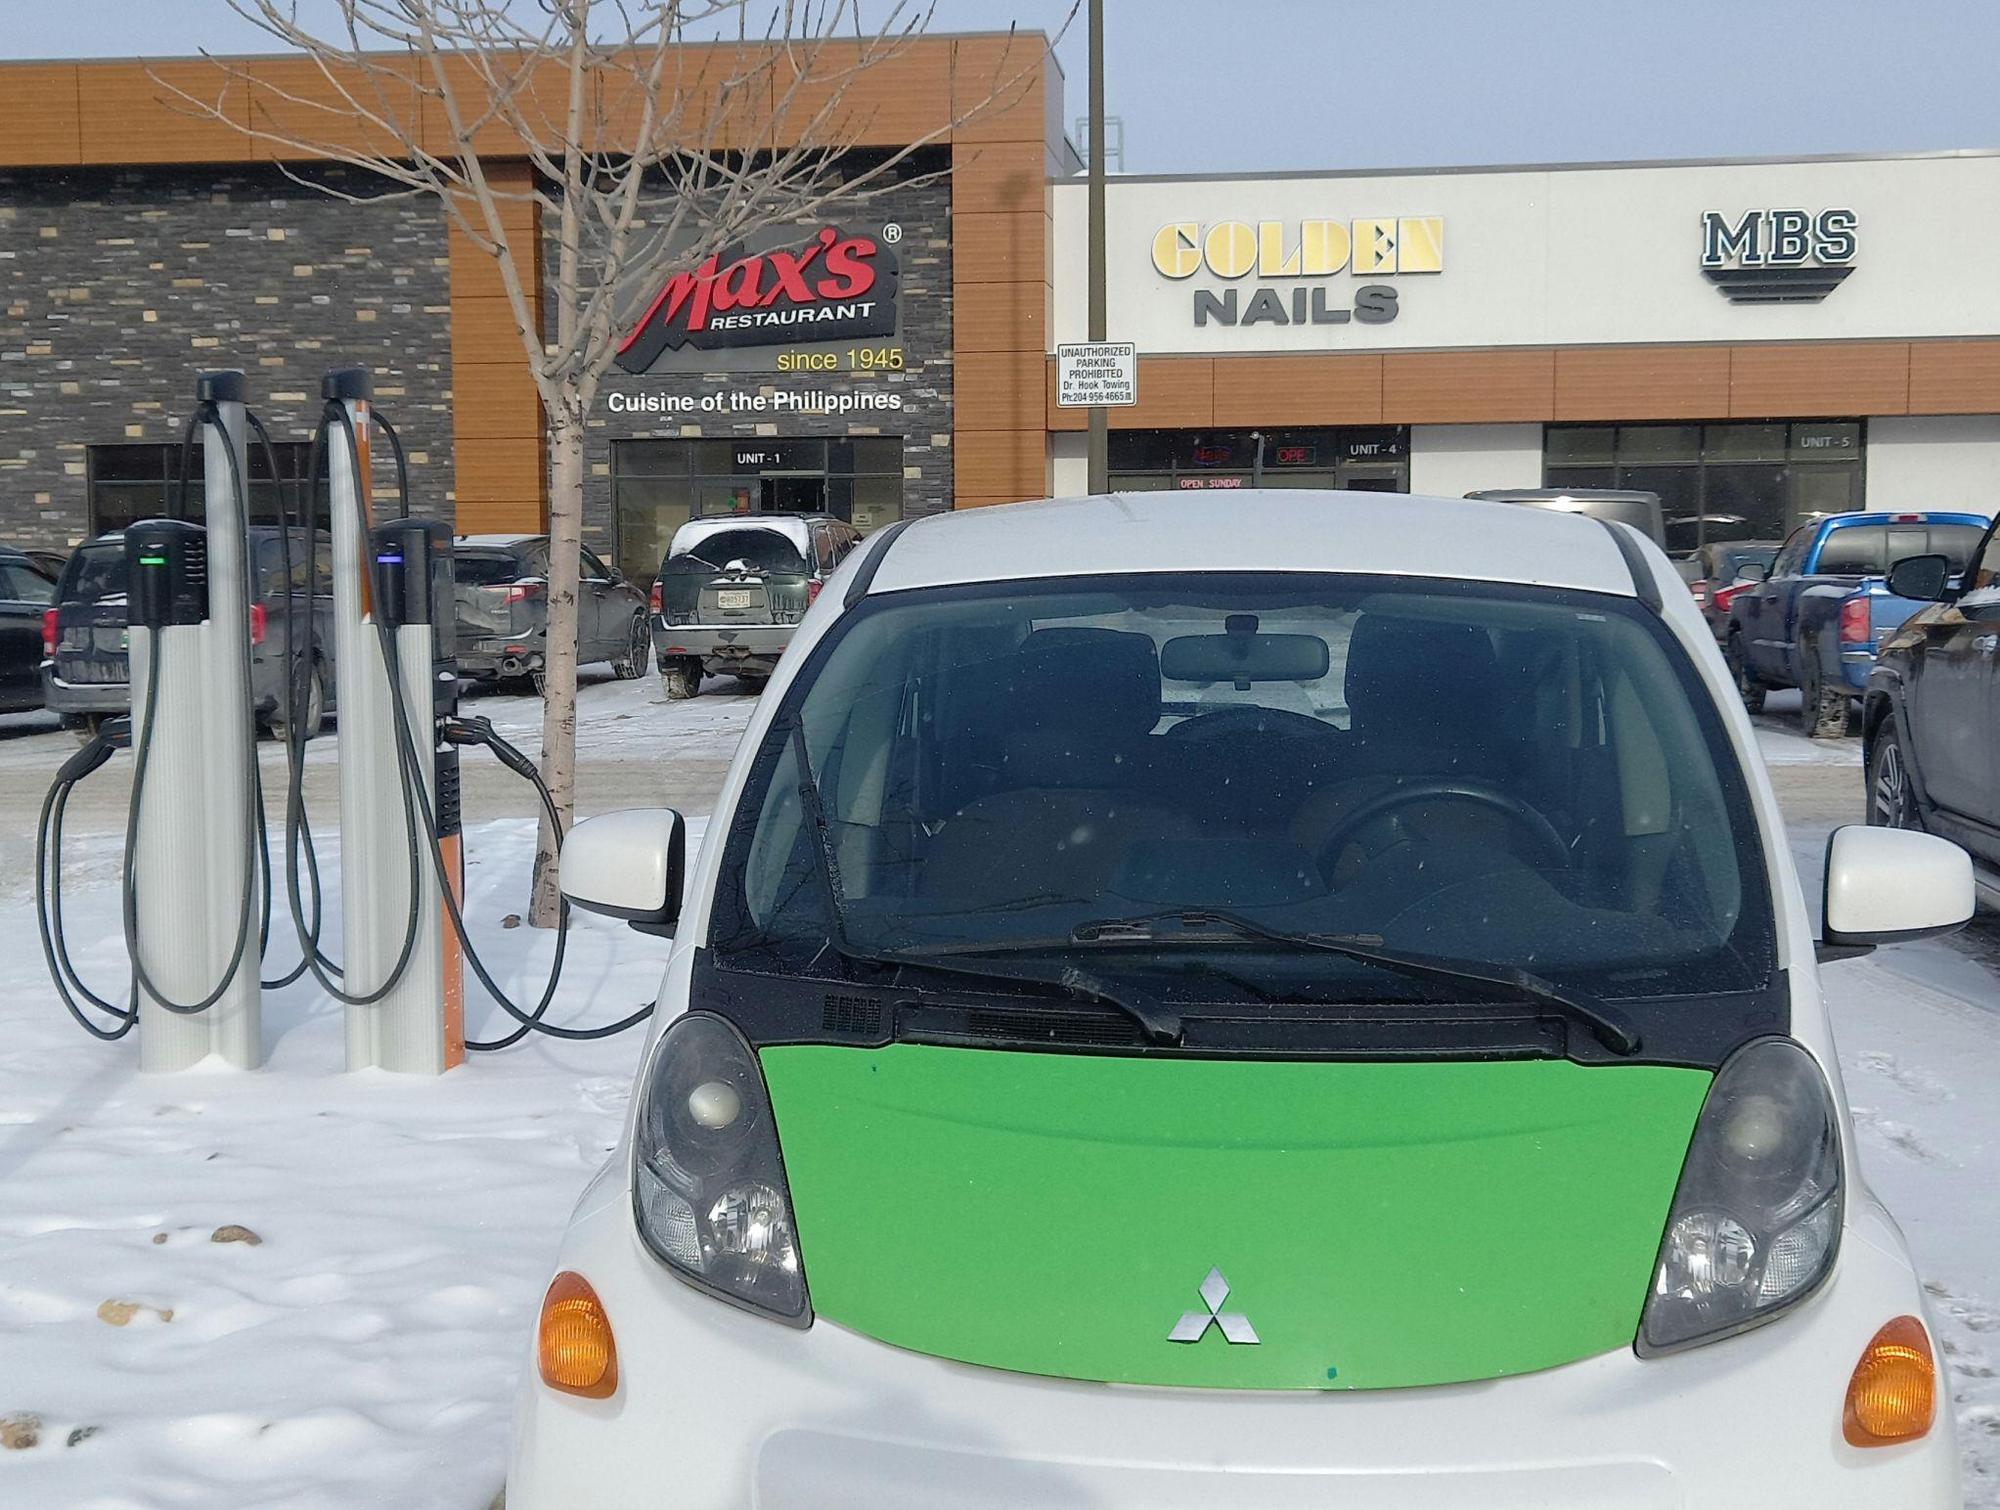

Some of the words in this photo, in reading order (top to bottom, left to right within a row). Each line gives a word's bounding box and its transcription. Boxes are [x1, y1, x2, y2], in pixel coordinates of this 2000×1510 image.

[1701, 207, 1858, 266] MBS
[1151, 215, 1444, 279] GOLDEN
[617, 225, 878, 353] Max's
[1193, 285, 1400, 327] NAILS
[710, 302, 877, 331] RESTAURANT
[1061, 346, 1131, 358] UNAUTHORIZED
[777, 350, 838, 371] since
[847, 348, 904, 369] 1945
[1076, 358, 1117, 368] PARKING
[1069, 369, 1123, 379] PROHIBITED
[1078, 380, 1099, 390] Hook
[1102, 380, 1130, 391] Towing
[608, 392, 694, 412] Cuisine
[701, 392, 725, 412] of
[731, 392, 767, 411] the
[774, 390, 901, 415] Philippines
[1801, 436, 1833, 448] UNIT
[1279, 448, 1309, 462] OPE
[1350, 444, 1380, 455] UNIT
[1388, 444, 1397, 454] 4
[737, 453, 765, 464] UNIT
[775, 453, 781, 464] 1
[1180, 479, 1204, 489] OPEN
[1209, 479, 1242, 488] SUNDAY
